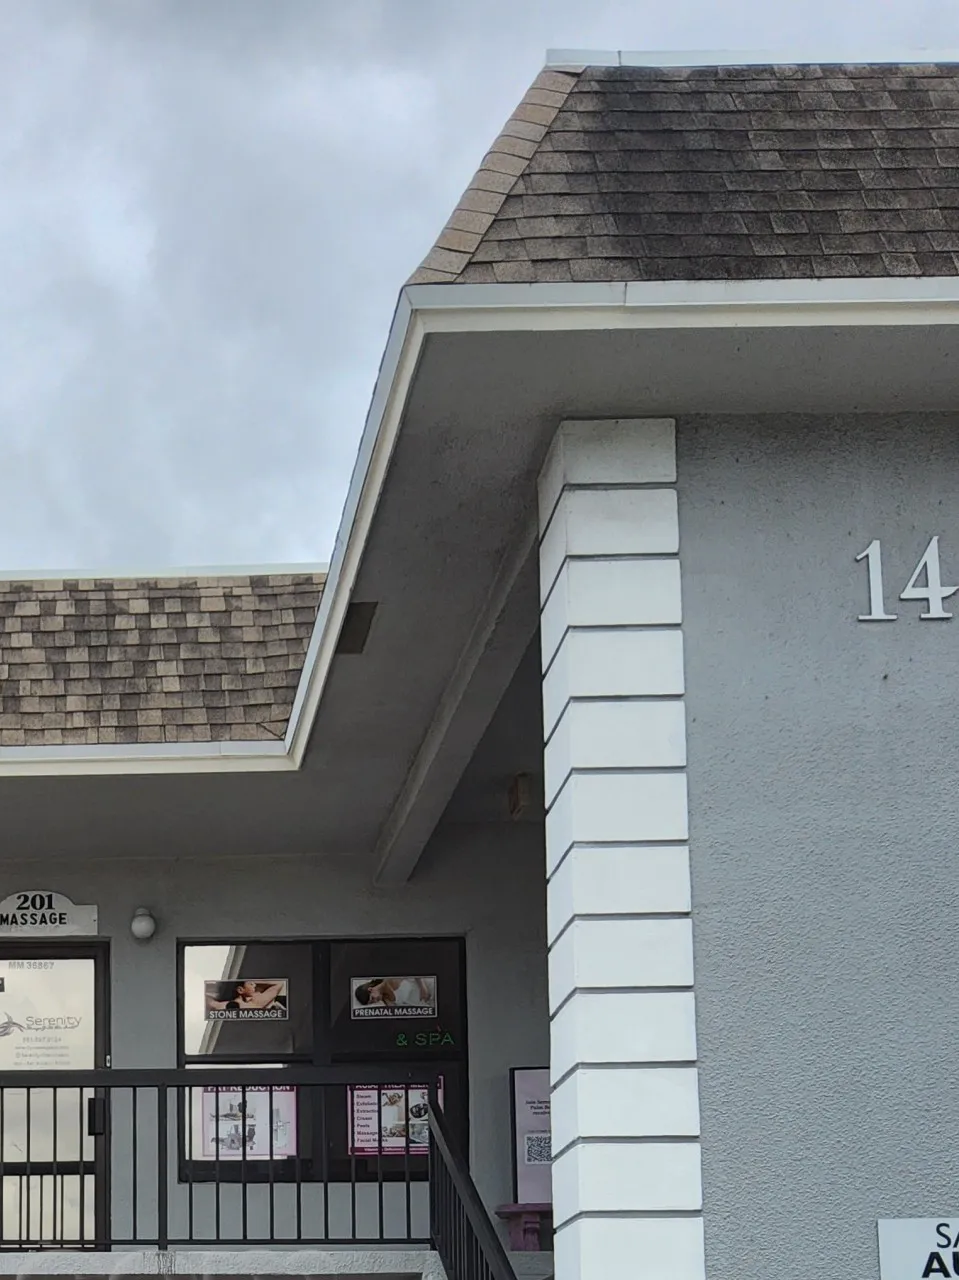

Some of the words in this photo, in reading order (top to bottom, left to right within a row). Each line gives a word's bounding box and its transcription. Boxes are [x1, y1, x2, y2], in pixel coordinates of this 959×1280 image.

[16, 894, 55, 910] 201
[0, 913, 67, 926] MASSAGE
[209, 1011, 237, 1019] STONE
[239, 1009, 283, 1018] MASSAGE
[355, 1008, 393, 1016] PRENATAL
[394, 1007, 433, 1015] MASSAGE
[25, 1016, 83, 1028] Serenity
[396, 1033, 408, 1046] &
[414, 1032, 455, 1046] SPA
